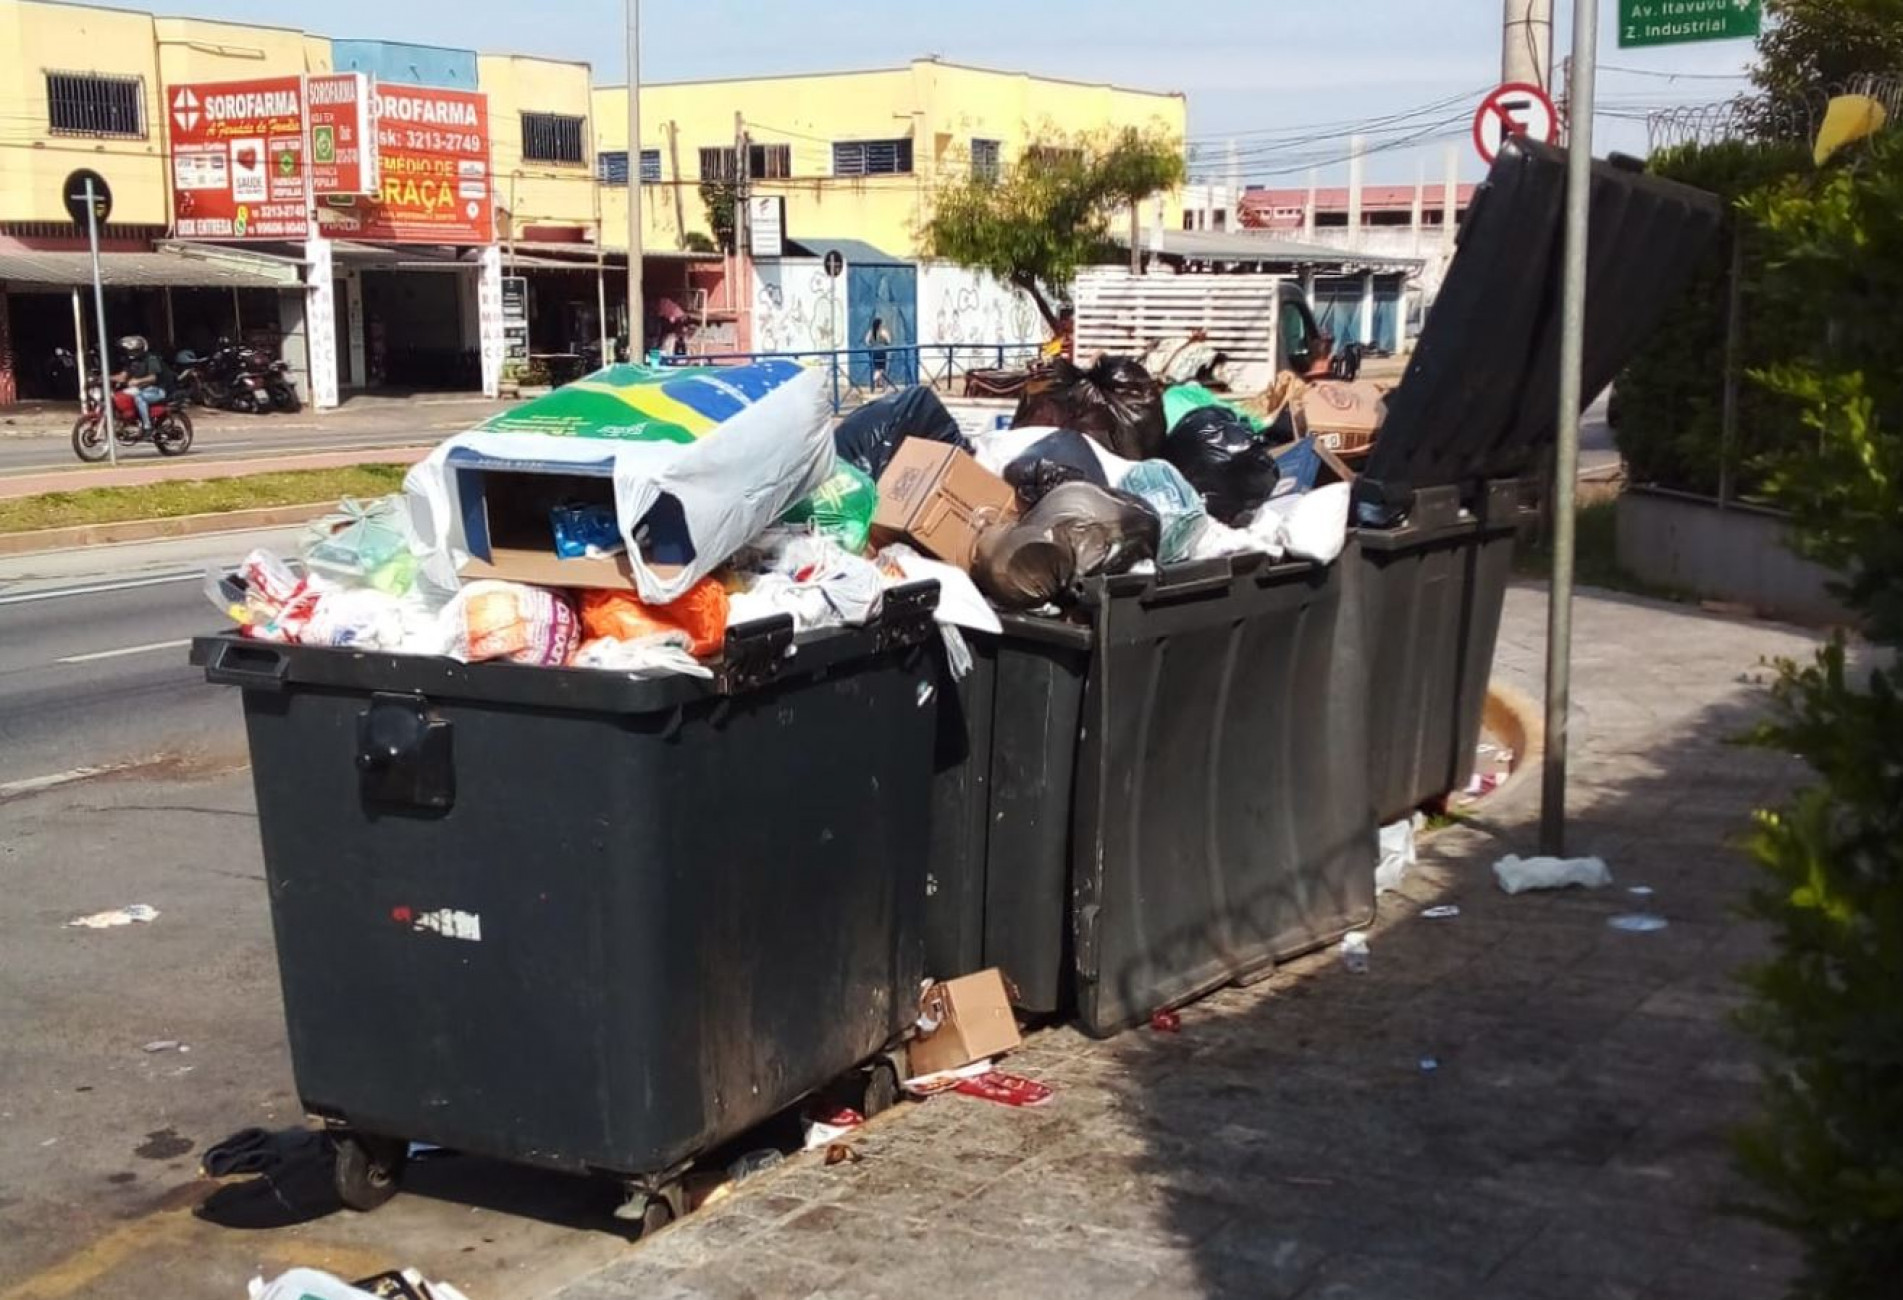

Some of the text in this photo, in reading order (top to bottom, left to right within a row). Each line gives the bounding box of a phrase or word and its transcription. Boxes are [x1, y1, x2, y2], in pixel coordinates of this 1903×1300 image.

[1631, 4, 1659, 18] Av.
[1625, 17, 1727, 39] Z. Industrial
[204, 90, 299, 121] SOROFARMA
[373, 94, 479, 127] OROFARMA
[406, 130, 481, 153] 3213-2749
[434, 160, 455, 177] DE
